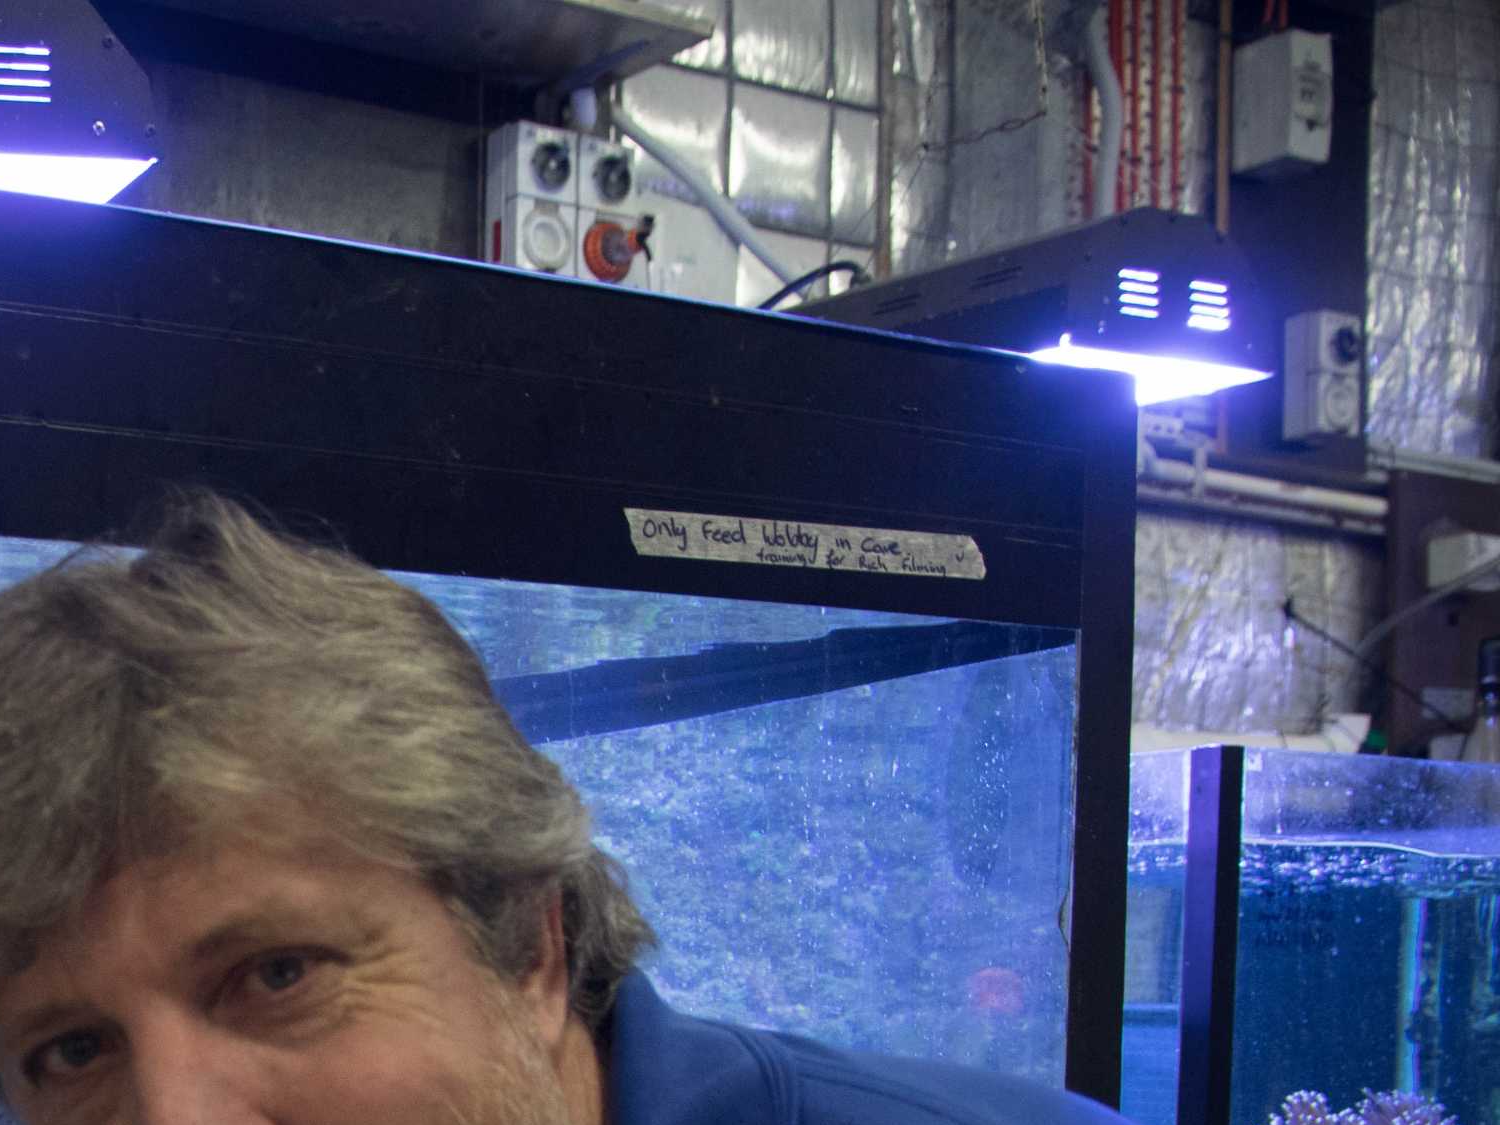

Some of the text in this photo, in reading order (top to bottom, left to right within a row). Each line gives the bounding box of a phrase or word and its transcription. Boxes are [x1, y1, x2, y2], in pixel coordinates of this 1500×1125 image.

[642, 517, 688, 552] Only
[835, 536, 852, 552] in
[825, 549, 846, 569] for
